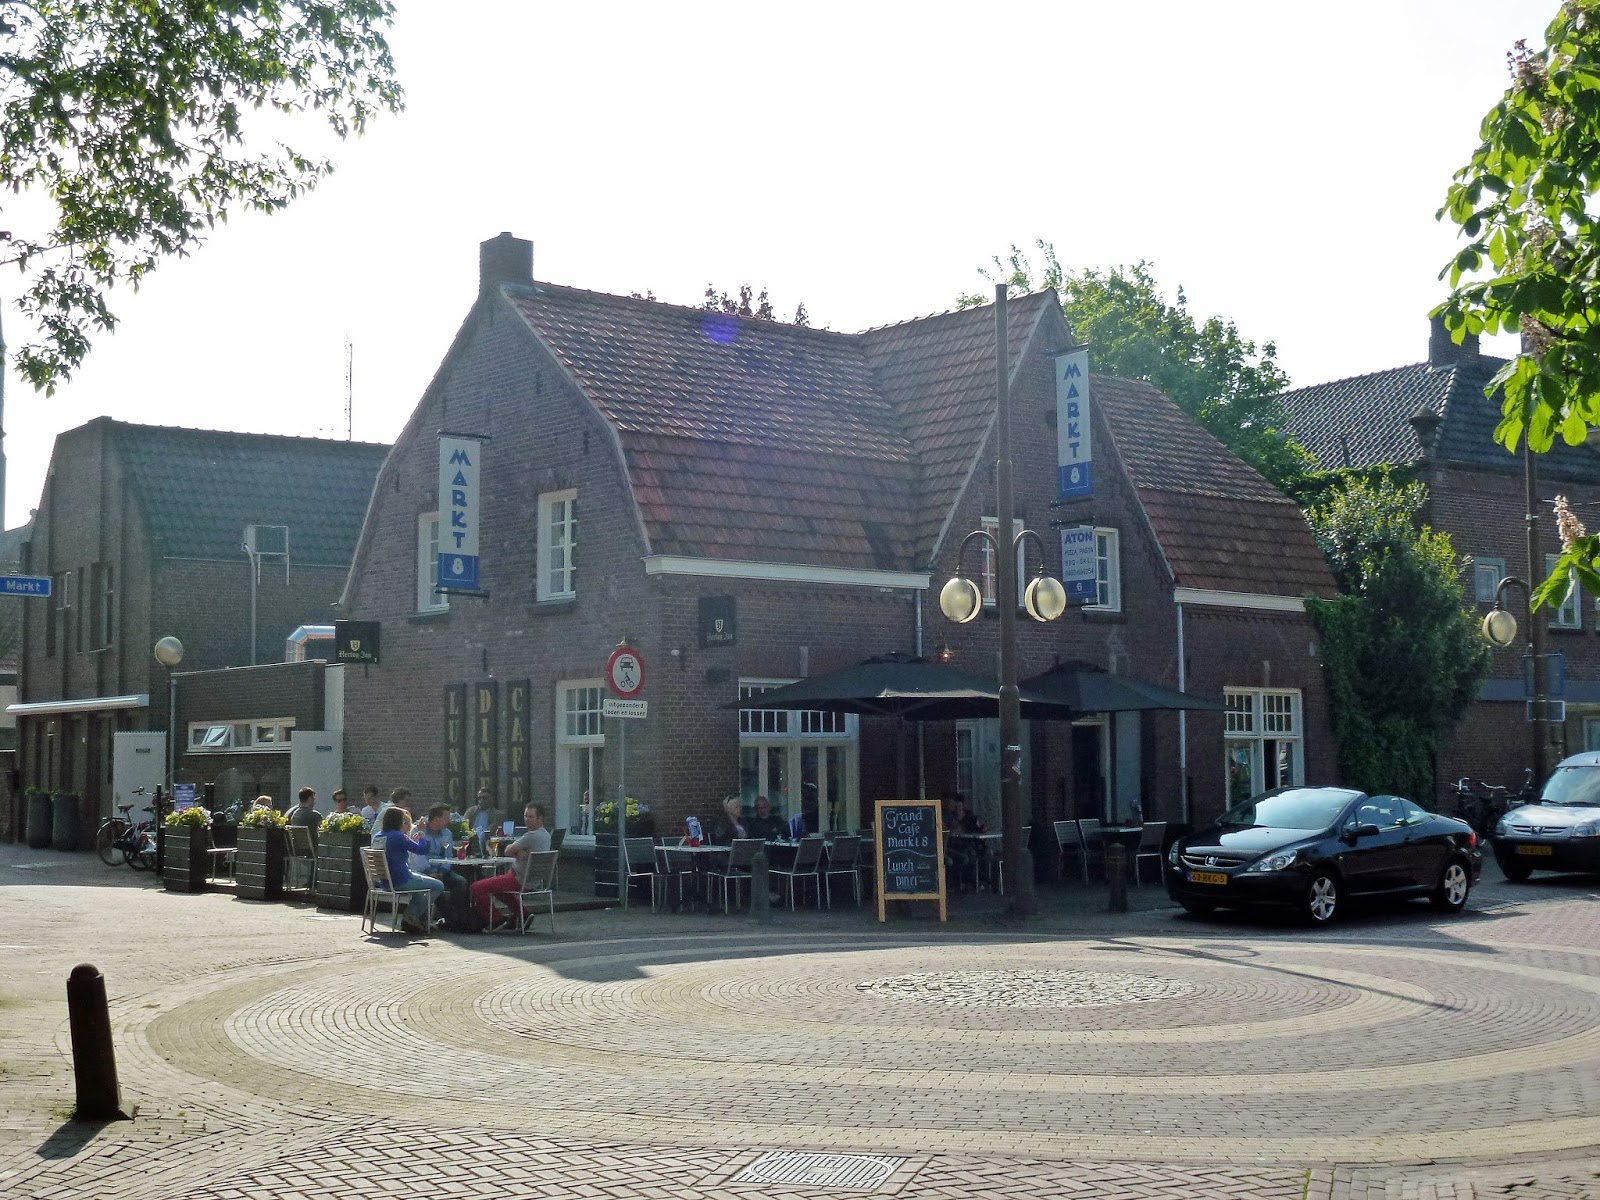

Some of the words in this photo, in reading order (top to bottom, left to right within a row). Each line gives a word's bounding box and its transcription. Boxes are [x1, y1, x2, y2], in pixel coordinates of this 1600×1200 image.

[1063, 362, 1082, 459] MARKT
[1070, 467, 1080, 484] 8
[448, 448, 472, 549] MARKT
[1064, 531, 1094, 545] ATON
[452, 557, 465, 575] 8
[6, 580, 40, 591] Markt
[1076, 582, 1083, 592] 6
[885, 810, 923, 830] Grand
[921, 836, 929, 847] 8
[887, 857, 914, 872] Lunch
